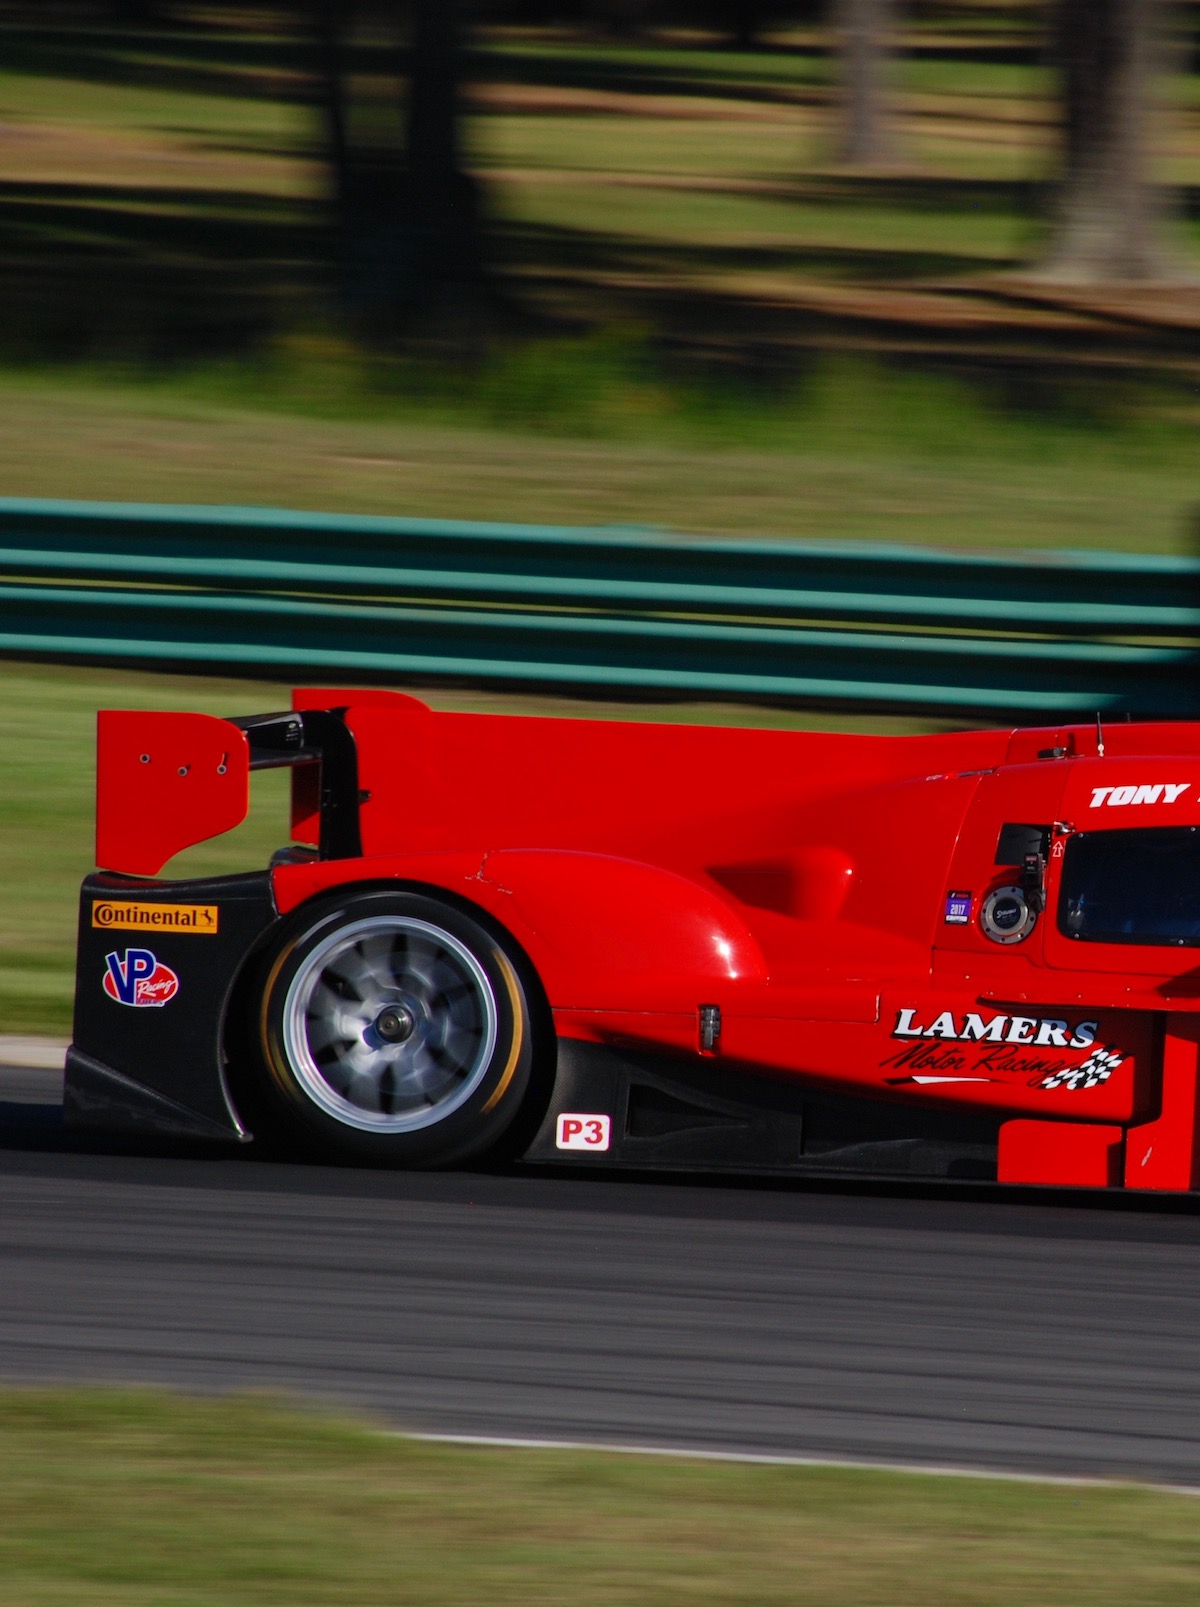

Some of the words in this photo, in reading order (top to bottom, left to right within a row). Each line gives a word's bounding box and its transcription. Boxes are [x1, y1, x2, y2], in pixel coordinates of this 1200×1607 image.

[1089, 783, 1191, 808] TONY
[94, 903, 197, 926] Continental
[950, 904, 966, 915] 2017
[105, 948, 157, 1005] VP
[137, 979, 176, 998] Racing
[892, 1008, 1099, 1049] LAMERS
[879, 1042, 967, 1070] Motor
[971, 1043, 1078, 1086] Racing
[562, 1119, 604, 1145] P3
